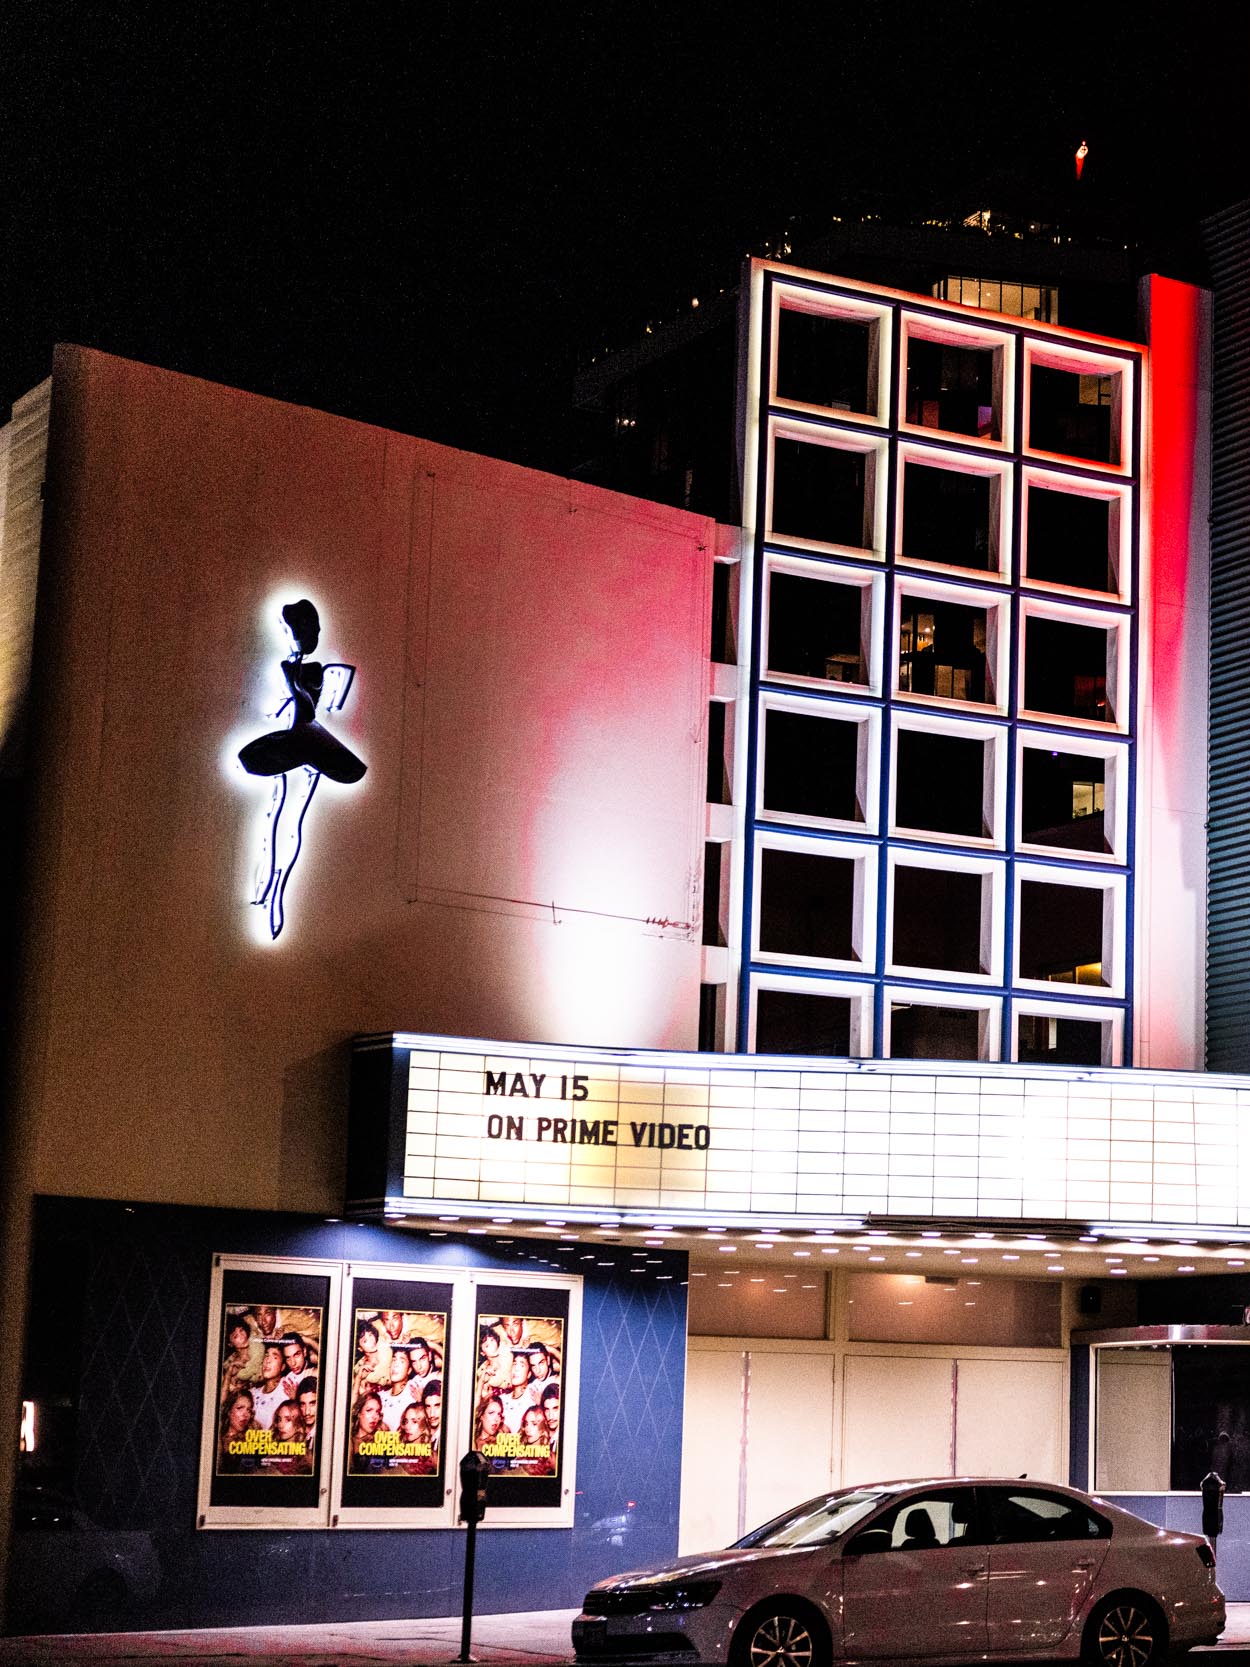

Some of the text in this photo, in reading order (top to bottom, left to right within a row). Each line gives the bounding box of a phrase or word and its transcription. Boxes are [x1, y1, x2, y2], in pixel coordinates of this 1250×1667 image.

[485, 1071, 589, 1101] MAY 15
[487, 1114, 711, 1150] ON PRIME VIDEO
[245, 1429, 272, 1442] OVER
[374, 1430, 400, 1444] OVER
[496, 1432, 521, 1445] OVER
[229, 1441, 306, 1455] COMPENSATING
[358, 1442, 432, 1456] COMPENSATING
[482, 1444, 551, 1458] COMPENSATING
